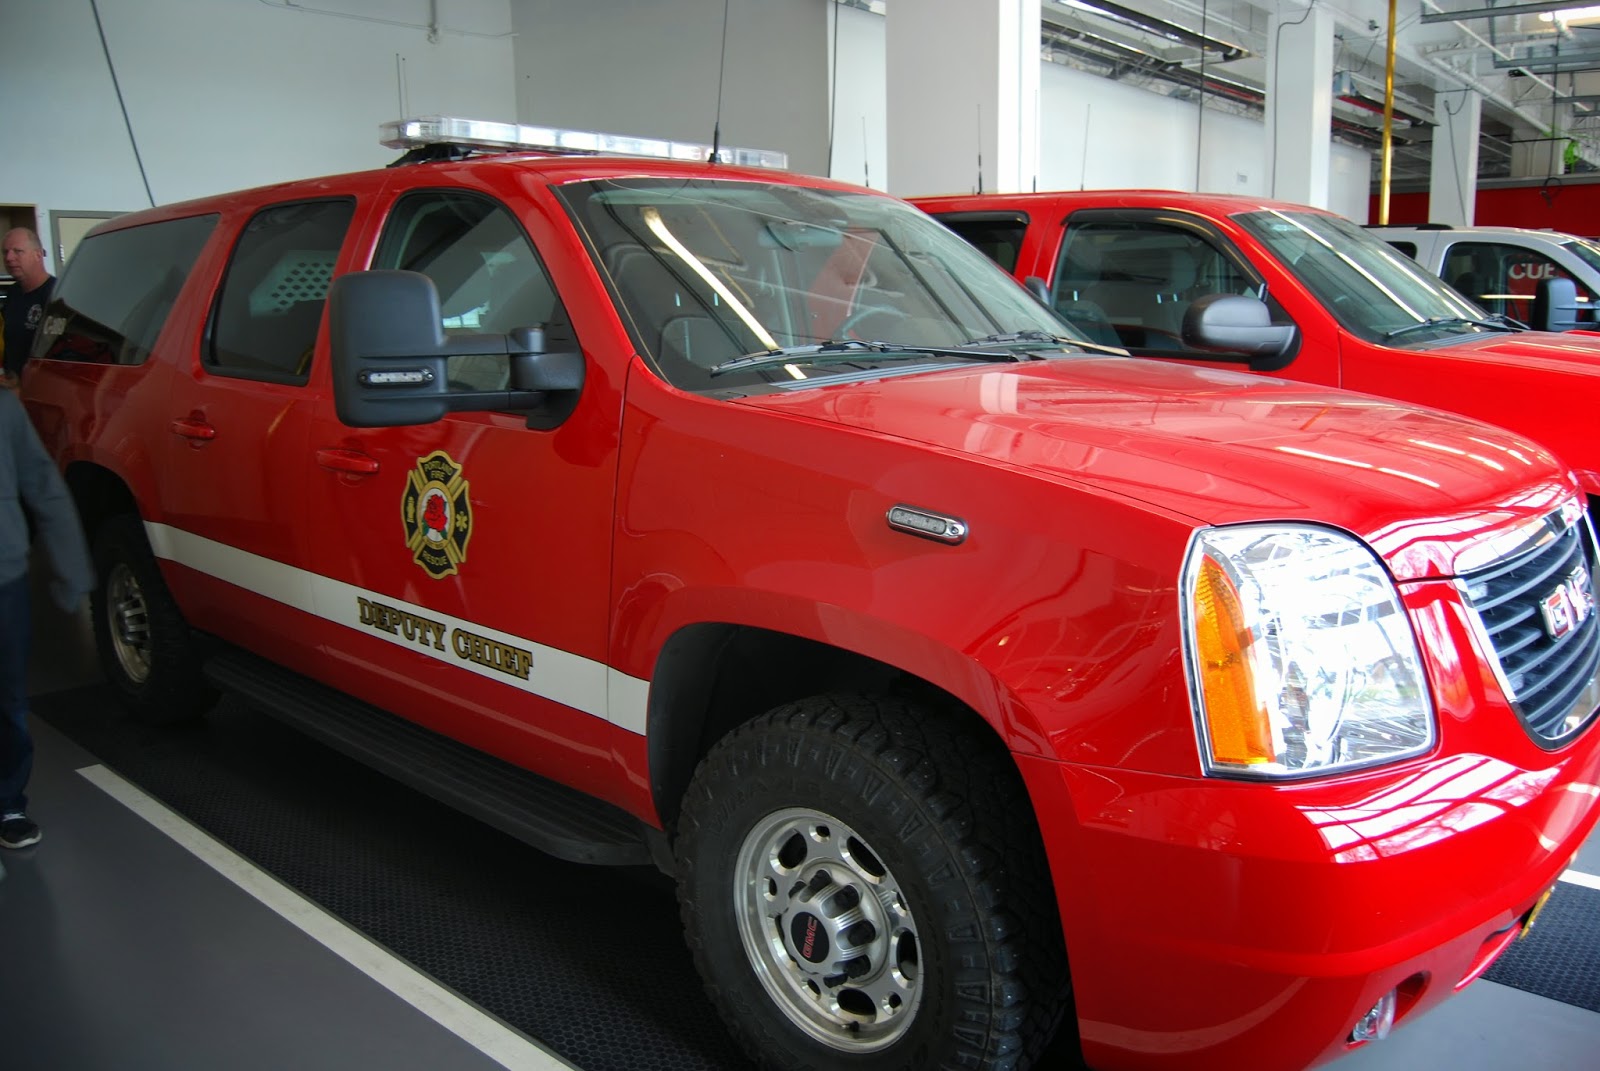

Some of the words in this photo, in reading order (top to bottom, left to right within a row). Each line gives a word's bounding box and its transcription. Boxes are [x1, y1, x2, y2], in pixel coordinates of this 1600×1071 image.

[424, 460, 453, 476] PORTLAND
[430, 470, 446, 481] FIRE
[422, 550, 448, 566] RESCUE
[357, 596, 447, 652] DEPUTY
[452, 627, 534, 681] CHIEF
[802, 915, 818, 959] GMC
